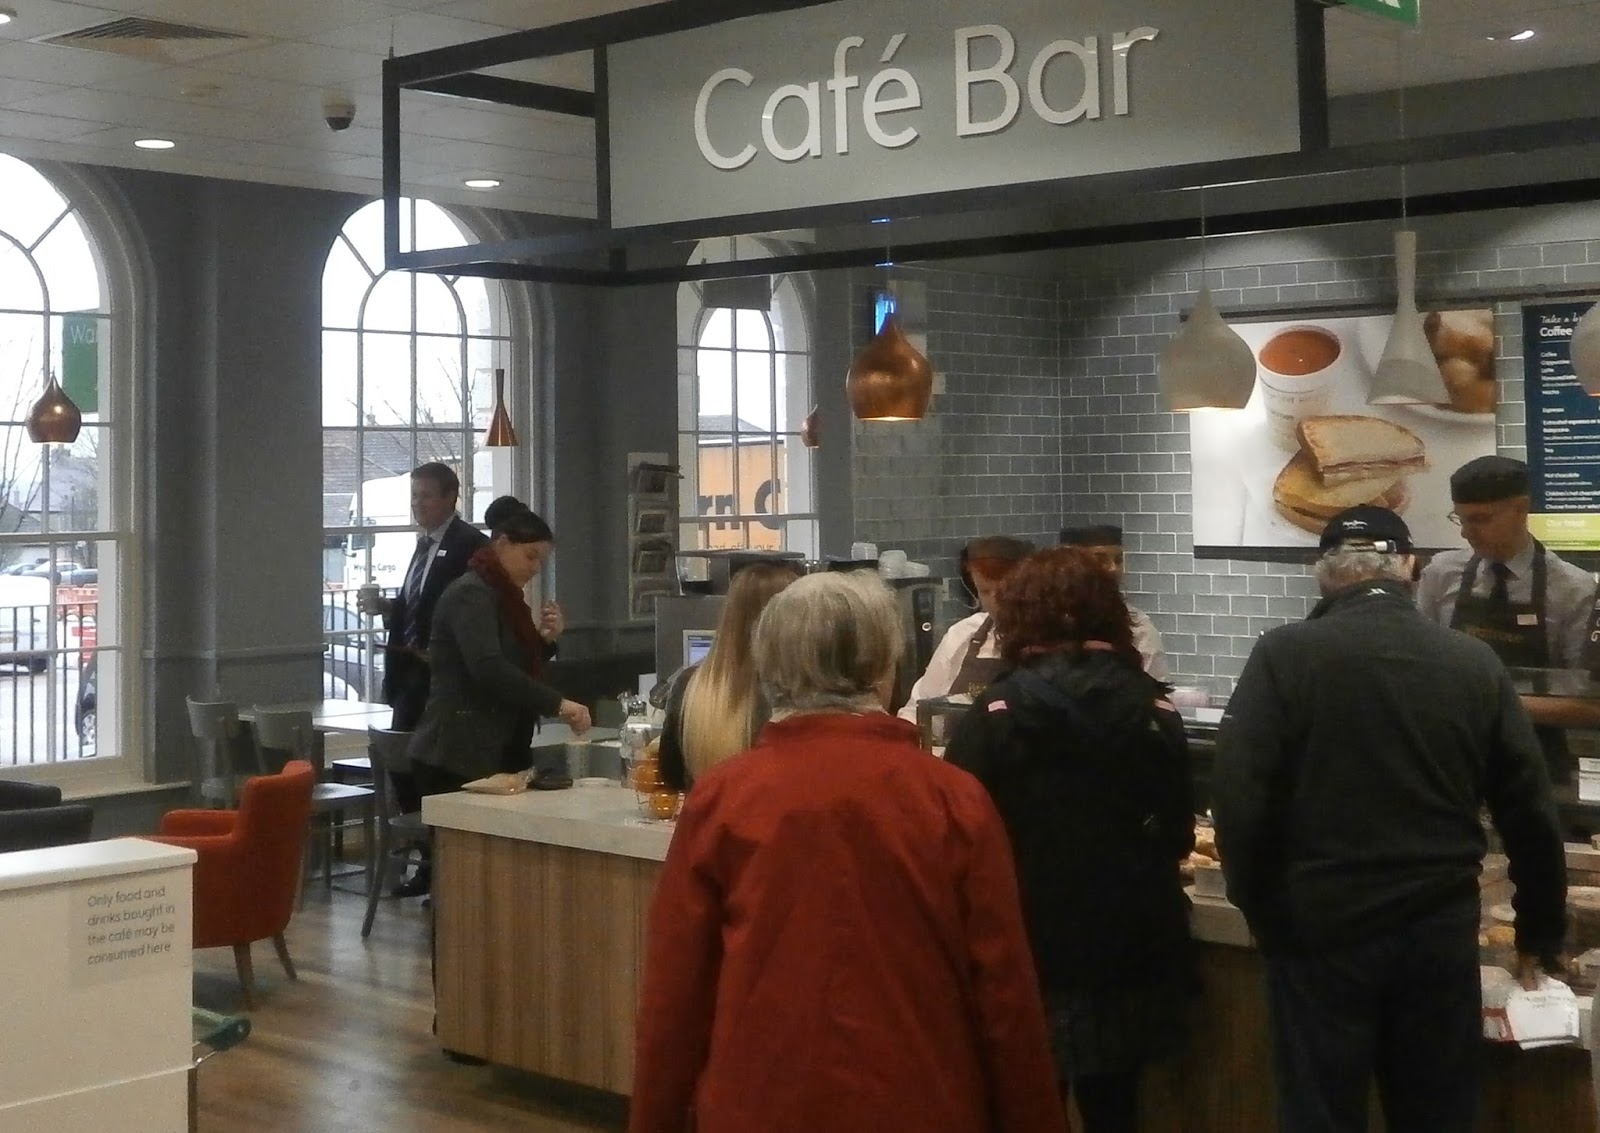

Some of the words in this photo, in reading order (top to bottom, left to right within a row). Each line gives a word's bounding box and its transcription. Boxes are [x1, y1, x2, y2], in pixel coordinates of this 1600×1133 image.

[694, 33, 921, 170] Café
[954, 24, 1160, 137] Bar
[1539, 325, 1573, 337] Coffee
[378, 563, 396, 573] Cargo
[88, 895, 113, 908] Only
[116, 888, 141, 903] food
[144, 886, 165, 899] and
[88, 914, 120, 926] drinks
[123, 904, 162, 921] bought
[166, 904, 175, 913] in
[88, 934, 106, 945] the
[134, 926, 158, 938] may
[161, 921, 175, 934] be
[88, 944, 145, 965] consumed
[147, 942, 171, 954] here
